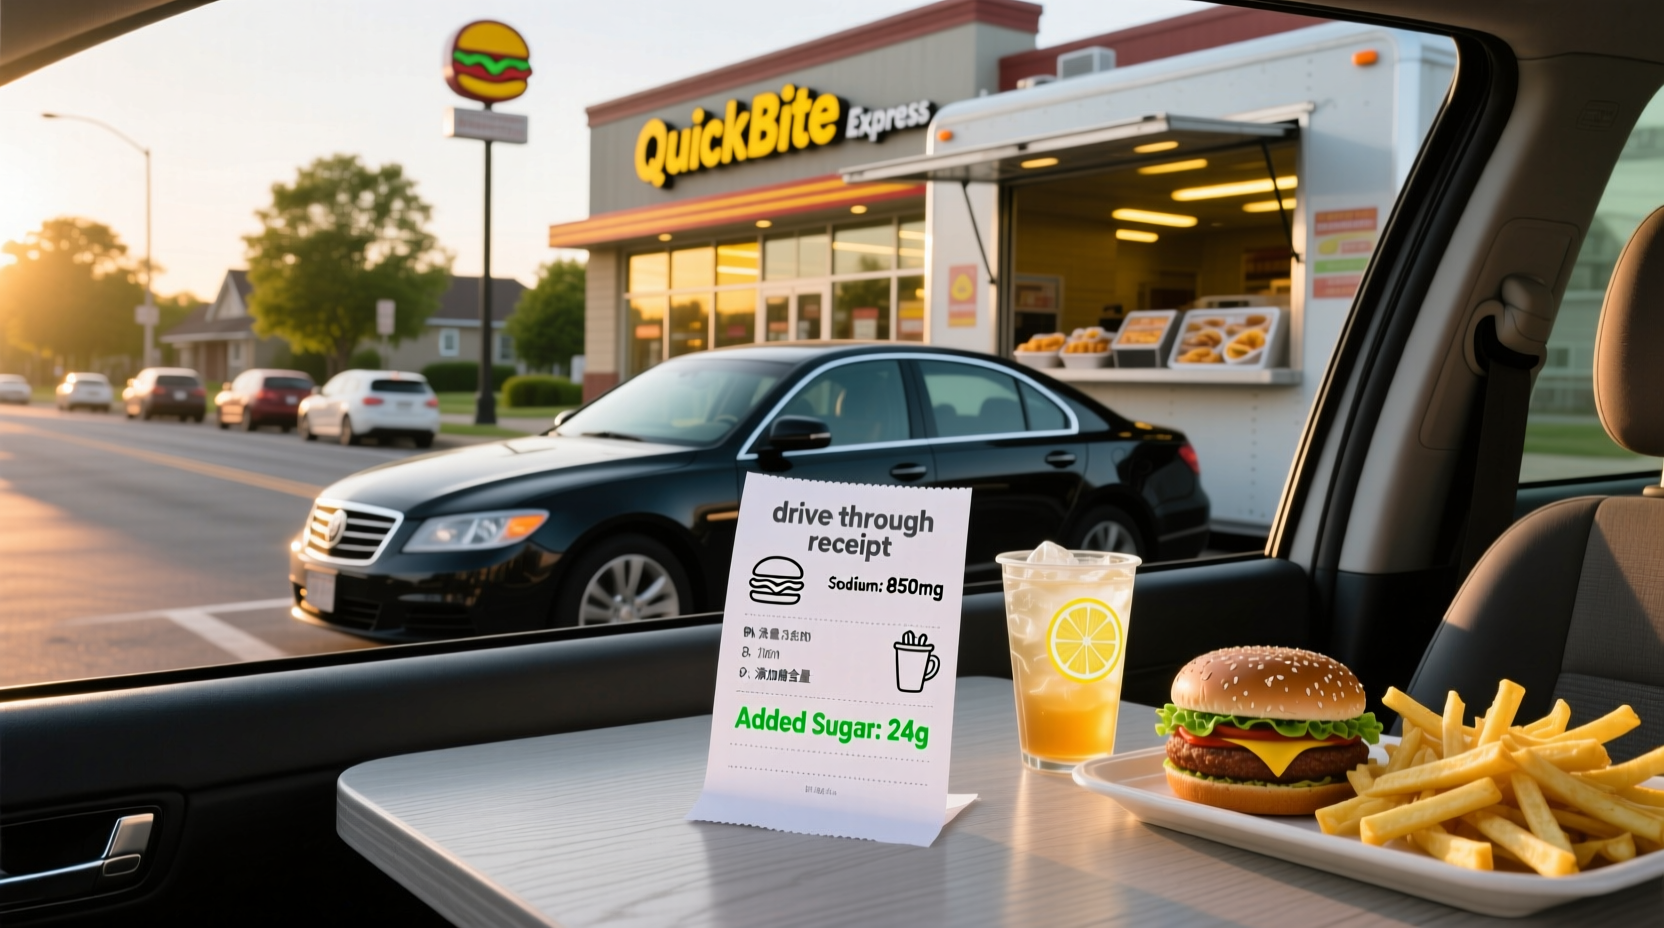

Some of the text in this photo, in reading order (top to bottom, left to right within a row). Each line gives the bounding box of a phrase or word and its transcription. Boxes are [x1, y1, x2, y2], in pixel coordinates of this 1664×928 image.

[634, 83, 931, 189] QuickBite Express
[772, 500, 934, 538] drive through
[807, 533, 893, 562] receipt
[827, 576, 944, 602] Sodium: 850mg
[734, 706, 930, 750] Added Sugar: 24g
